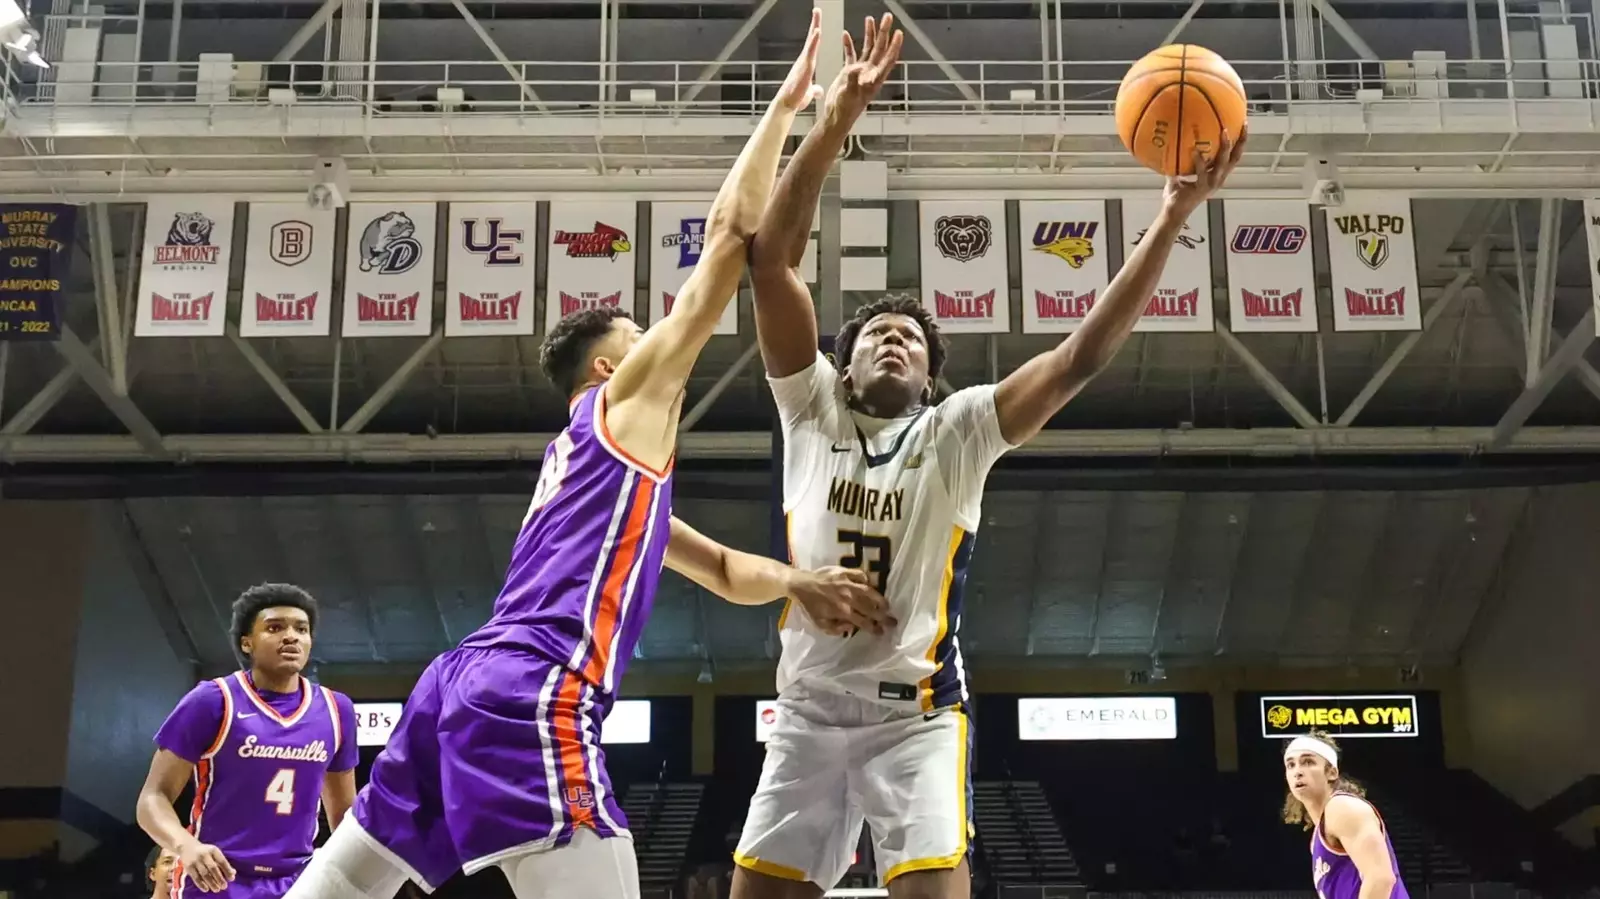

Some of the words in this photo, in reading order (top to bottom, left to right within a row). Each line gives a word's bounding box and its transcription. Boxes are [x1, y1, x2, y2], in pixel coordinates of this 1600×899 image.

[2, 211, 58, 223] MURRAY
[1334, 215, 1404, 234] VALPO
[8, 224, 49, 235] STATE
[662, 234, 706, 247] SYCAMO
[1032, 222, 1098, 246] UNI
[1231, 225, 1307, 254] UIC
[0, 236, 64, 252] NIVERSITY
[155, 246, 220, 262] BELMONT
[279, 228, 303, 257] B
[460, 218, 524, 267] UE
[9, 256, 38, 268] OVC
[378, 237, 423, 274] D
[0, 279, 60, 290] AMPIONS
[1055, 290, 1075, 298] THE
[152, 291, 215, 321] VALLEY
[256, 291, 319, 321] VALLEY
[357, 291, 420, 321] VALLEY
[459, 291, 522, 321] VALLEY
[934, 288, 996, 318] VALLEY
[1141, 287, 1199, 316] ALLEY
[1241, 288, 1303, 317] VALLEY
[1344, 286, 1406, 316] VALLEY
[20, 321, 50, 332] 2022
[369, 712, 391, 728] B's
[1066, 707, 1168, 722] EMERALD
[1296, 708, 1360, 725] MEGA
[1362, 706, 1412, 725] GYM
[1393, 724, 1412, 732] 24/7
[238, 734, 328, 763] Evansville
[264, 768, 296, 816] 4
